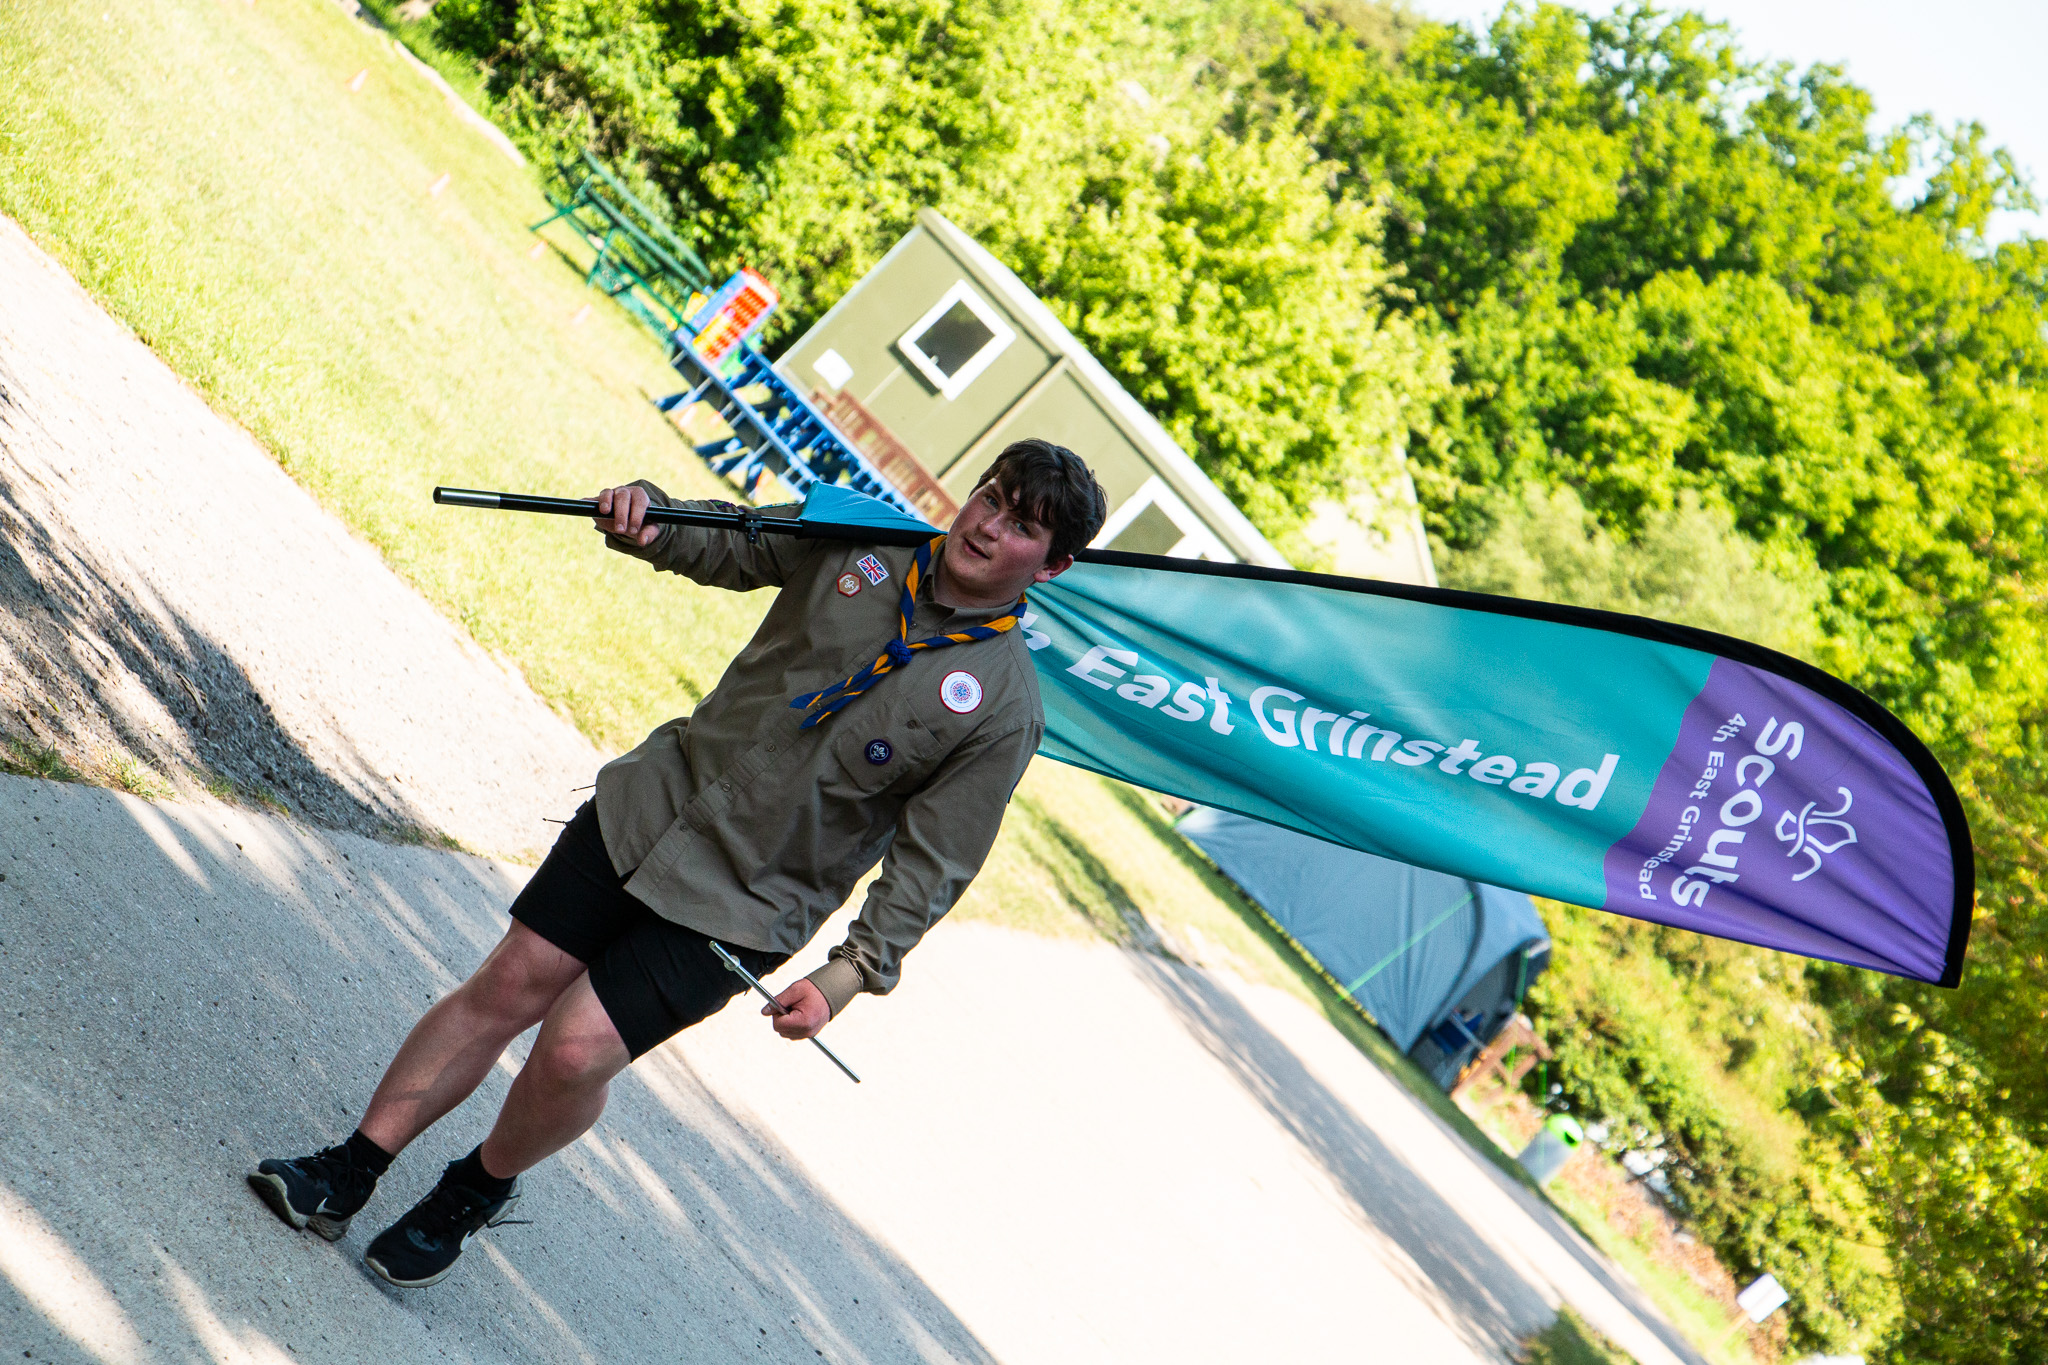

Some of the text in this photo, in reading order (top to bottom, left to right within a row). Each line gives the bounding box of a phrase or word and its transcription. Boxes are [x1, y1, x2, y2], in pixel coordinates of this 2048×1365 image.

[1065, 645, 1621, 811] East Grinstead
[1639, 713, 1747, 901] 4th East Grinstead
[1671, 716, 1805, 908] Scouts
